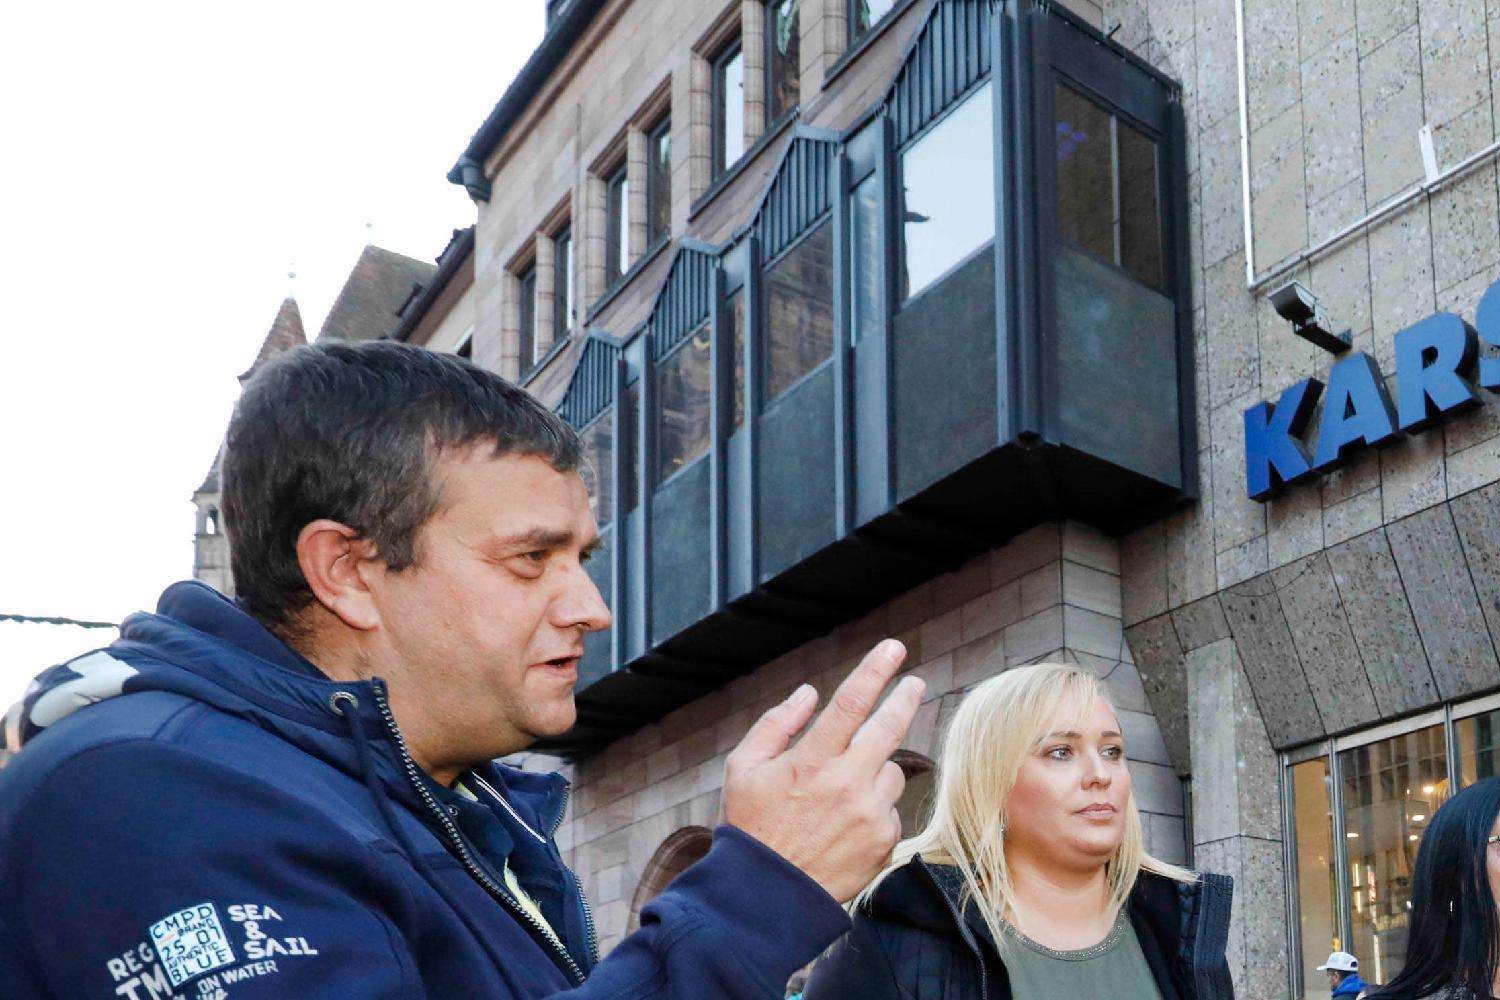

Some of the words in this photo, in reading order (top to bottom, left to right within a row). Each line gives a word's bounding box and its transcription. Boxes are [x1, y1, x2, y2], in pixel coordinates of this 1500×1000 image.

[152, 906, 213, 939] CMPD
[227, 904, 283, 922] SEA
[244, 921, 267, 940] &
[106, 942, 155, 982] REG
[244, 937, 318, 959] SAIL
[171, 949, 227, 982] BLUE
[197, 974, 221, 993] ON
[221, 960, 279, 984] WATER
